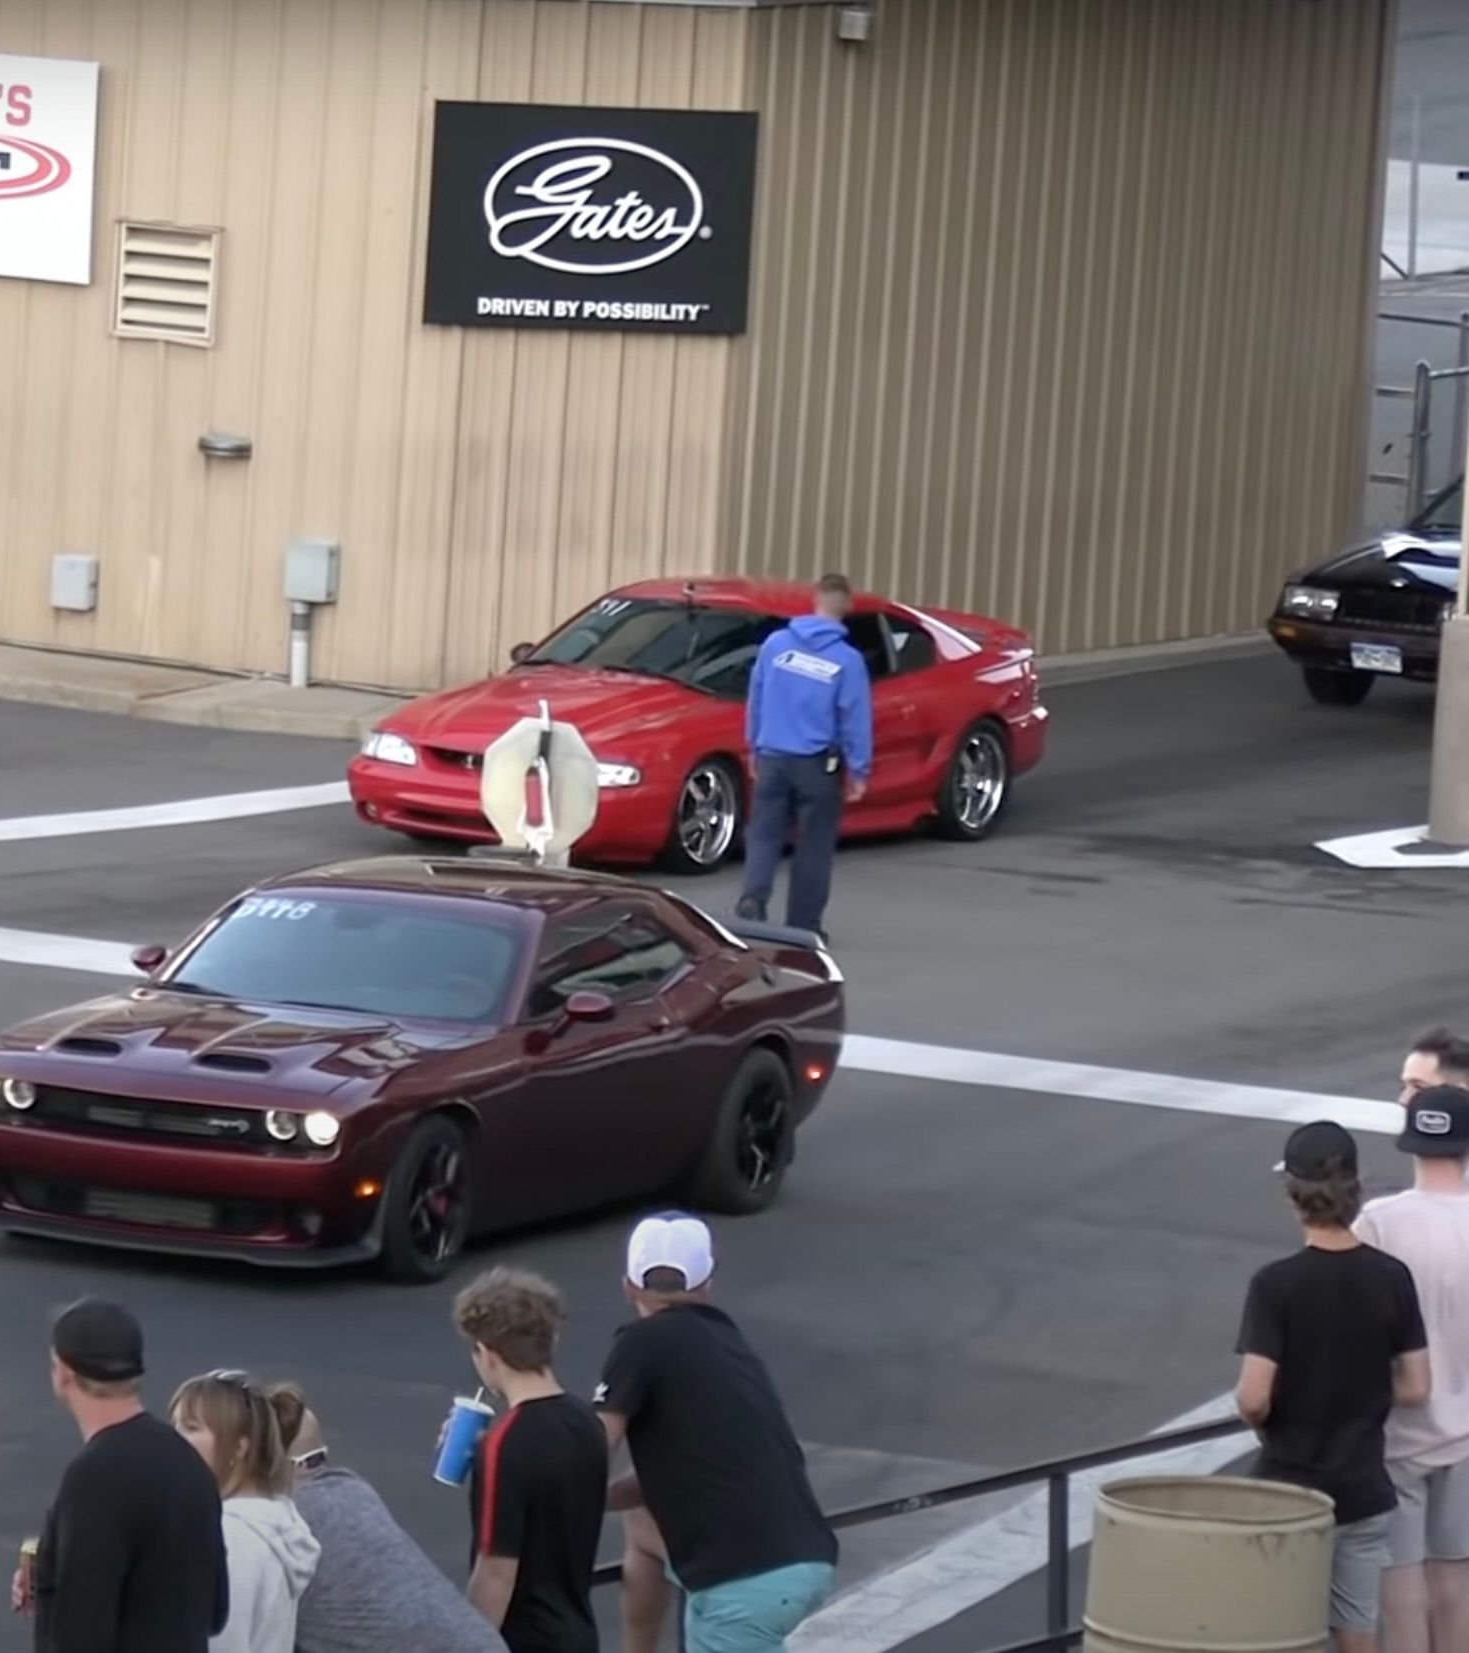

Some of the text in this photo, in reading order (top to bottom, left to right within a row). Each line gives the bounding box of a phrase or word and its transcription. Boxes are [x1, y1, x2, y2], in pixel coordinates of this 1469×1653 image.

[490, 155, 688, 257] Gates
[477, 298, 549, 317] DRIVEN
[554, 300, 580, 318] BY
